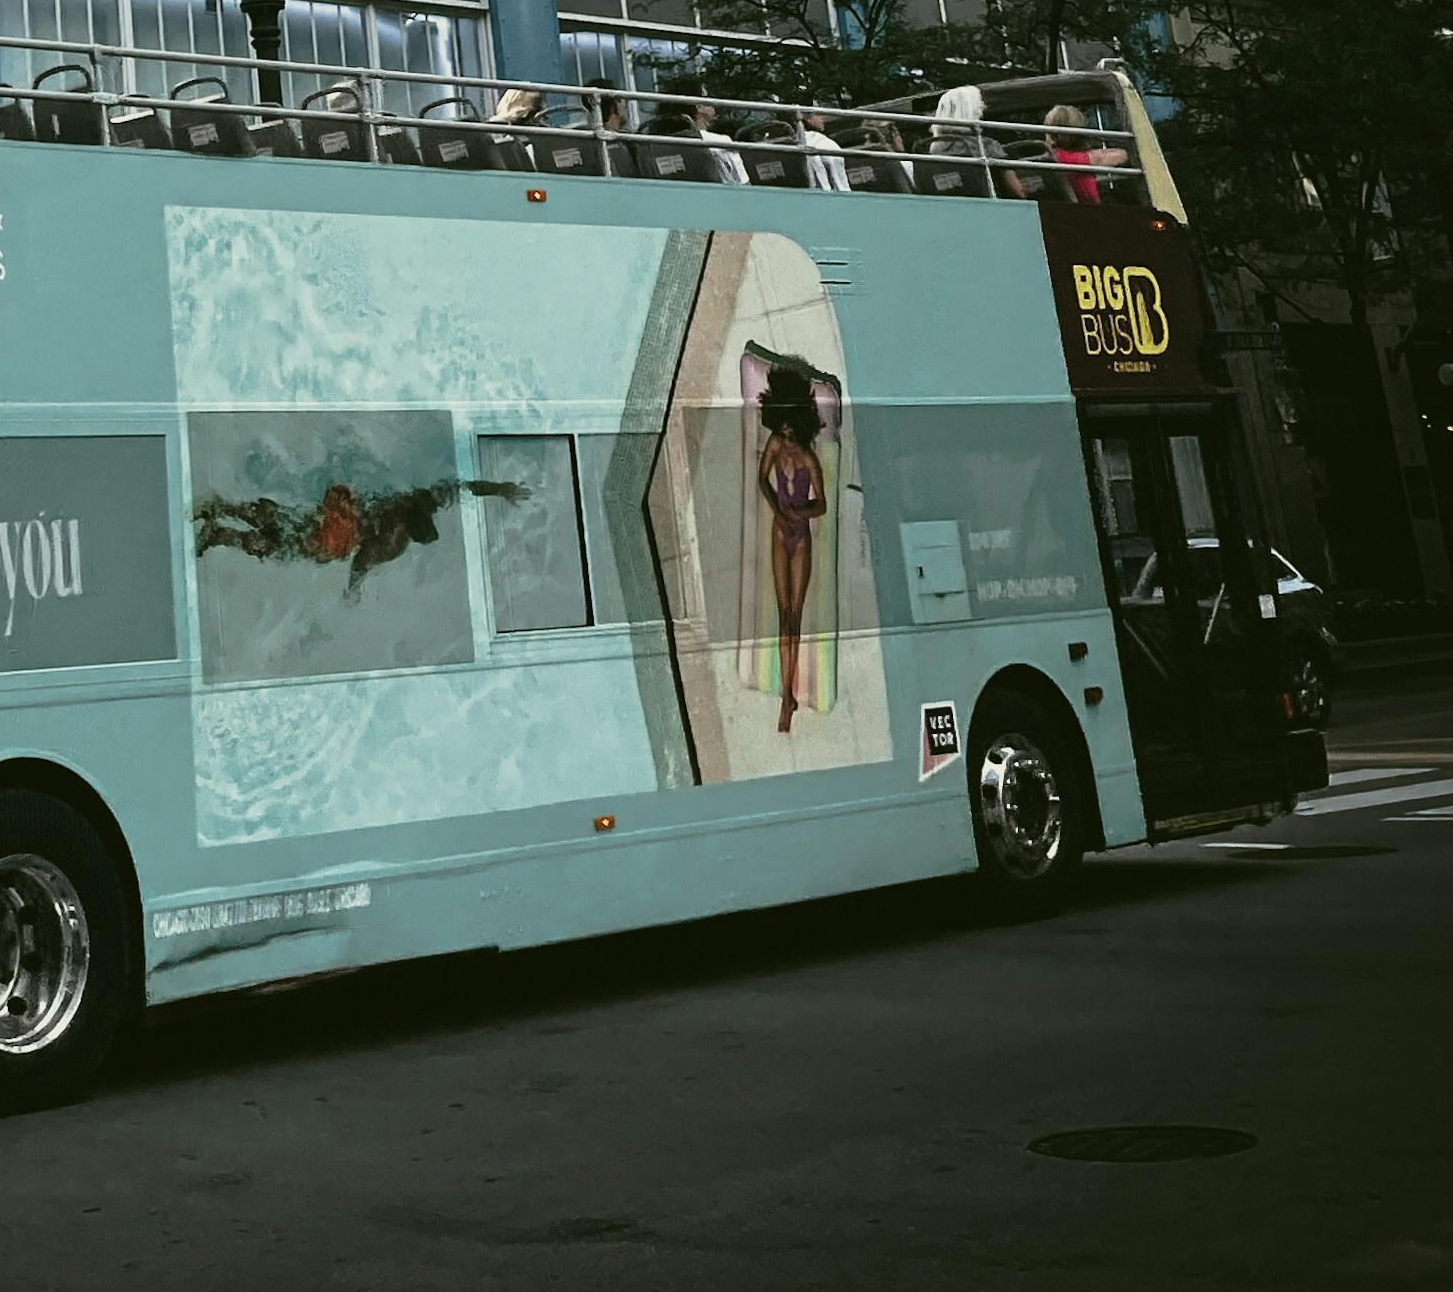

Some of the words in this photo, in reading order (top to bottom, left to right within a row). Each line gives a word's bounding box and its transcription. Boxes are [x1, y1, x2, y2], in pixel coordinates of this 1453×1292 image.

[1072, 264, 1124, 310] BIG
[1080, 313, 1134, 356] BUS
[929, 714, 952, 729] VEC
[931, 731, 955, 747] TOR
